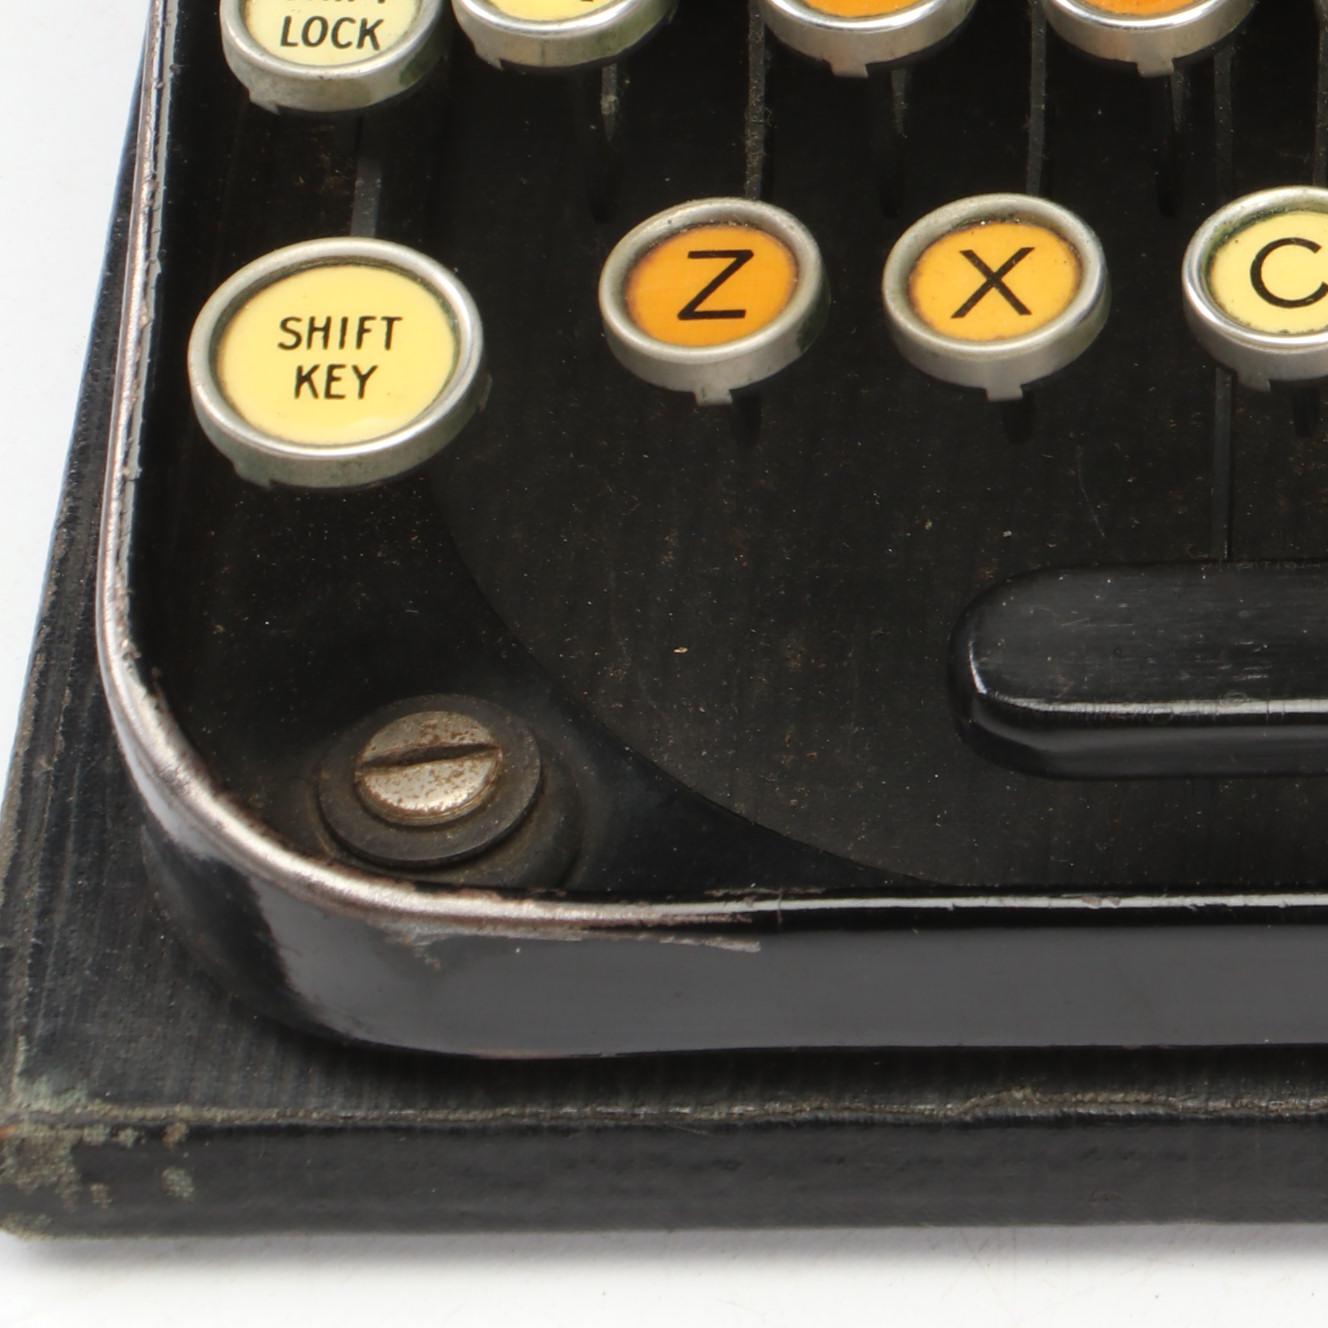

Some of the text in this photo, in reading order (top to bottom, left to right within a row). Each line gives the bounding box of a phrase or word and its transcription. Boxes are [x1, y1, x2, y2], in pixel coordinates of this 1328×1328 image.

[280, 16, 383, 51] LOCK
[677, 249, 755, 321] Z
[951, 246, 1034, 319] X
[278, 315, 402, 351] SHIFT
[294, 364, 378, 400] KEY
